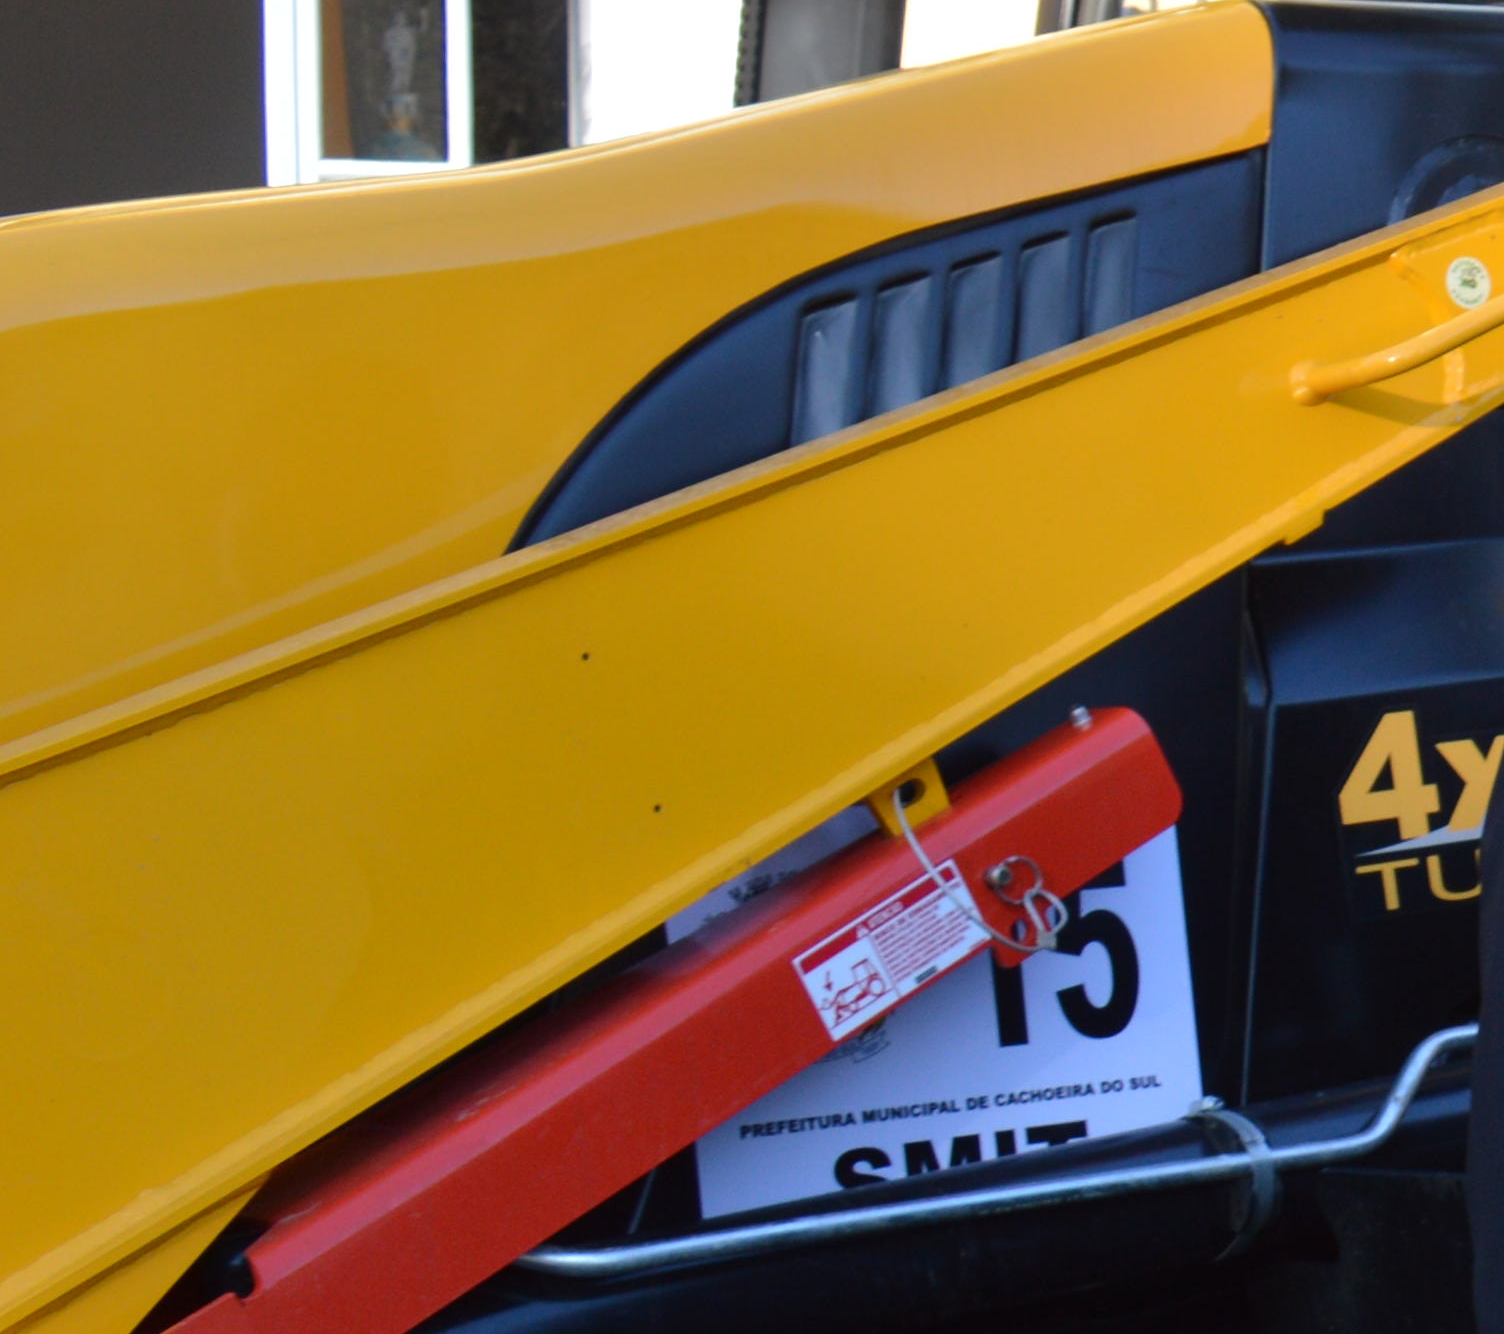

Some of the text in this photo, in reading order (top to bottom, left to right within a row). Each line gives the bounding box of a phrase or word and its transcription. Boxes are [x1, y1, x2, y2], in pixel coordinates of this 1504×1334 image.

[1355, 849, 1483, 910] TU
[739, 1074, 1162, 1140] PREFEITURA MUNICIPAL DE CACHOEIRA DO SUL
